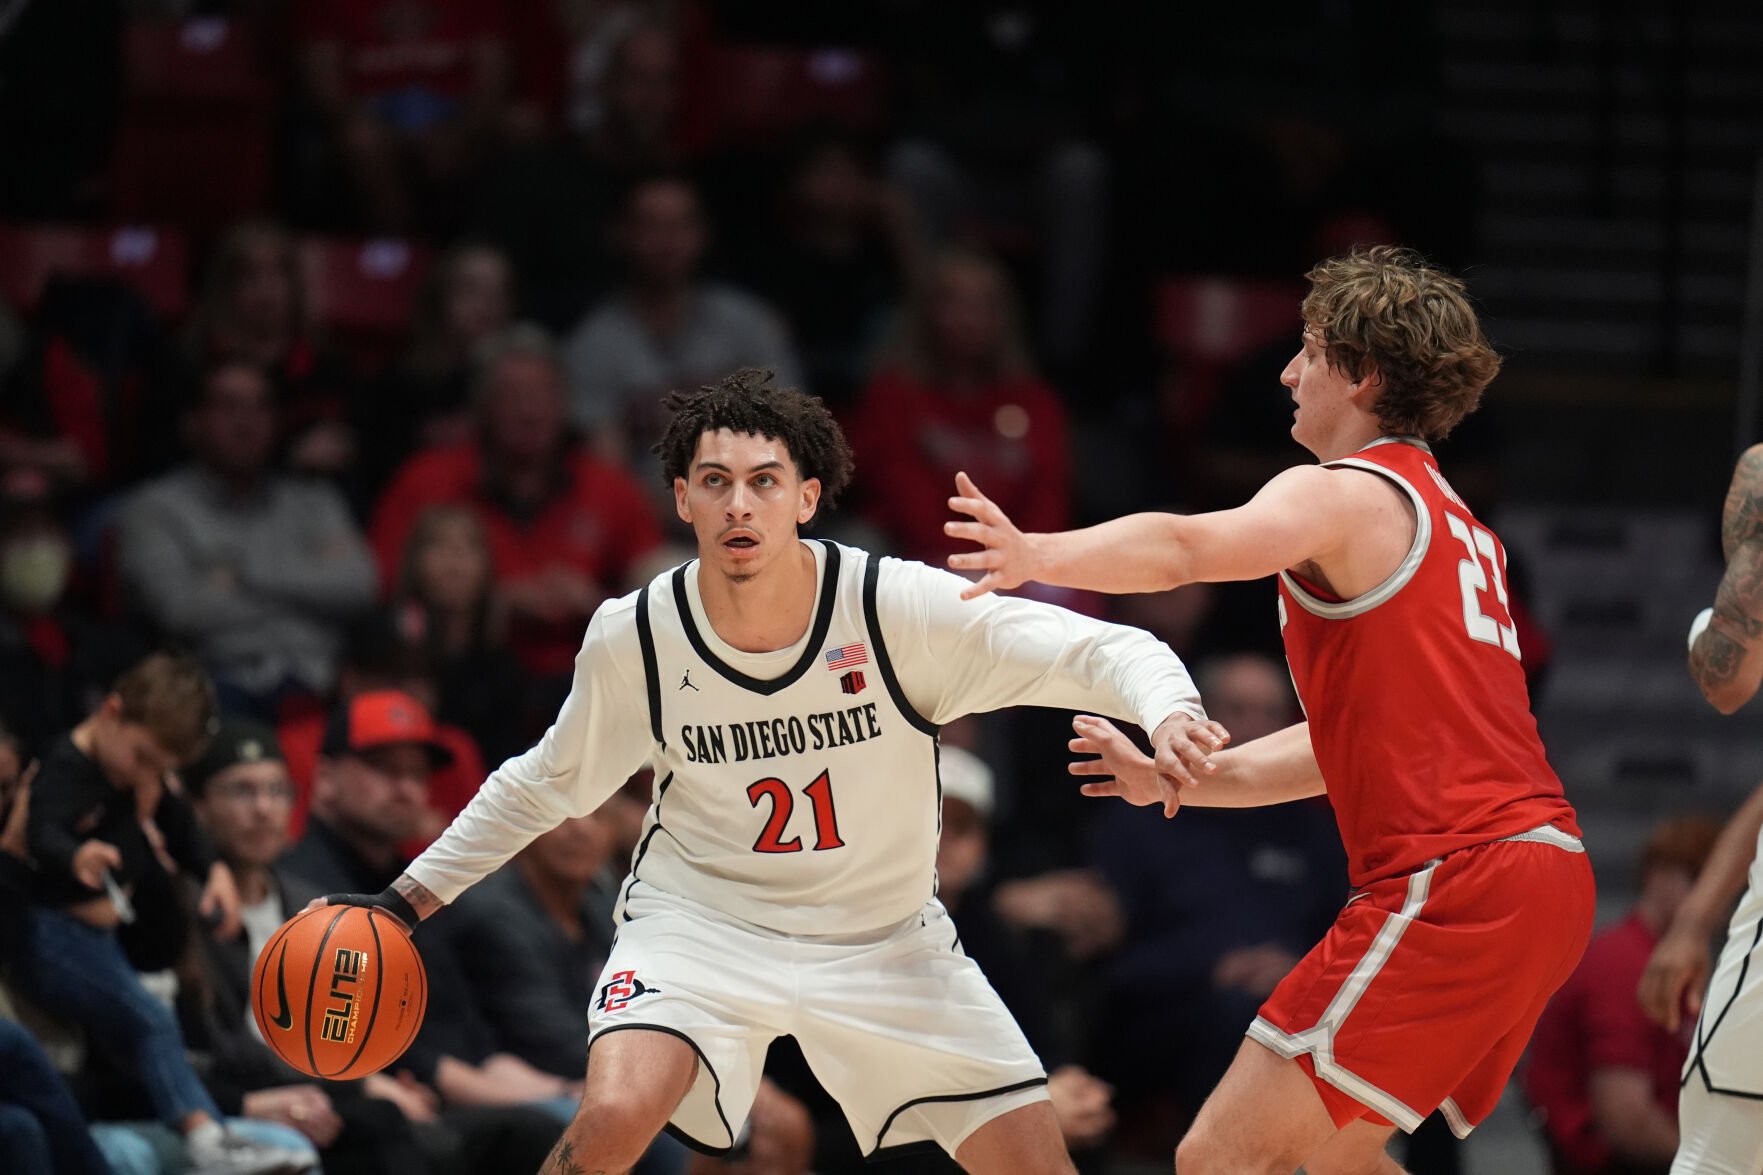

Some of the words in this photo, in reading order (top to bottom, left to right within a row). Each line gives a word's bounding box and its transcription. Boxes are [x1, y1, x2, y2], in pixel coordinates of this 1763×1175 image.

[681, 724, 727, 764] SAN
[728, 716, 806, 762] DIEGO
[807, 702, 882, 751] STATE
[746, 767, 846, 854] 21
[321, 947, 361, 1043] ELITE
[347, 952, 368, 1044] CHAMPIOHIP
